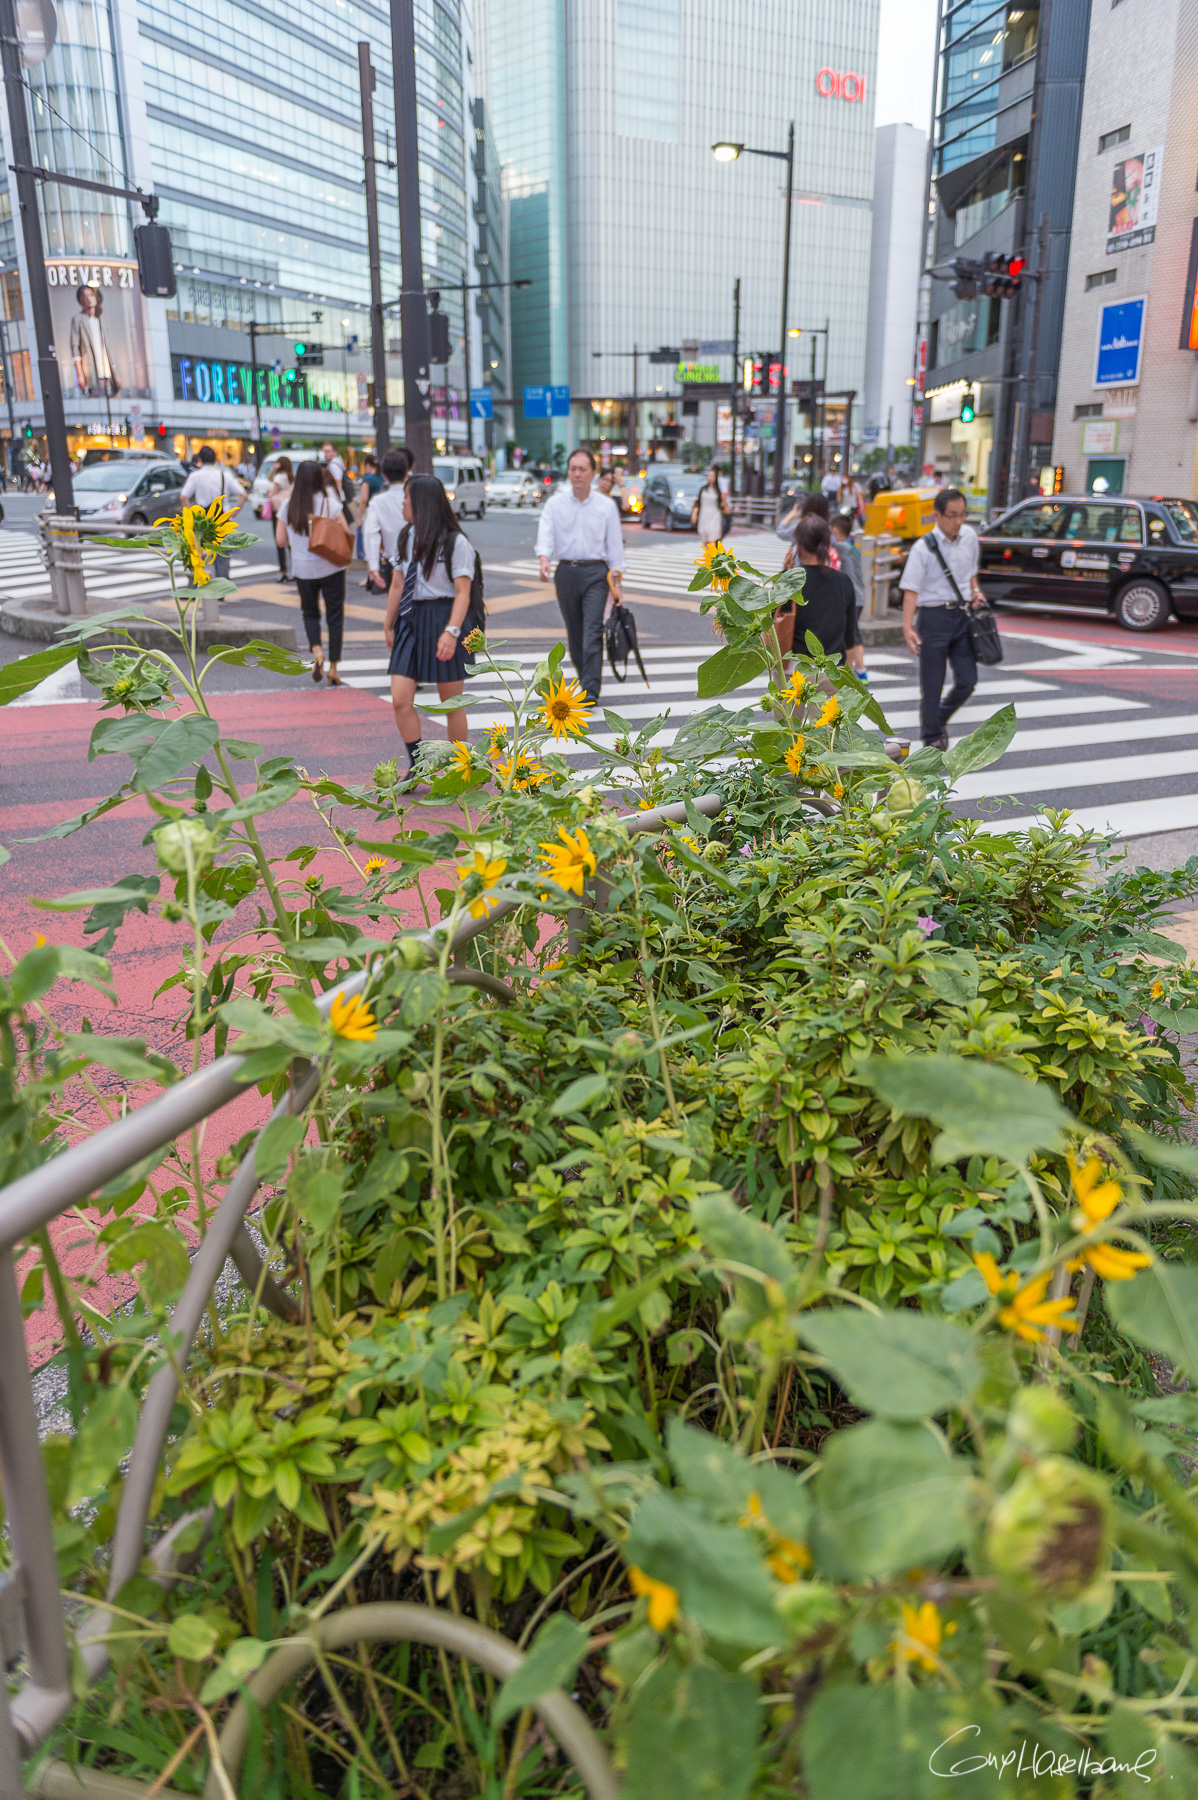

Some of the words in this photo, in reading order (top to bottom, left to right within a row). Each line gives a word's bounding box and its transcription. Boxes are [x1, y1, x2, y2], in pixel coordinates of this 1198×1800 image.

[48, 265, 113, 287] OREVER
[118, 267, 134, 288] 21
[180, 359, 281, 408] FOREVER
